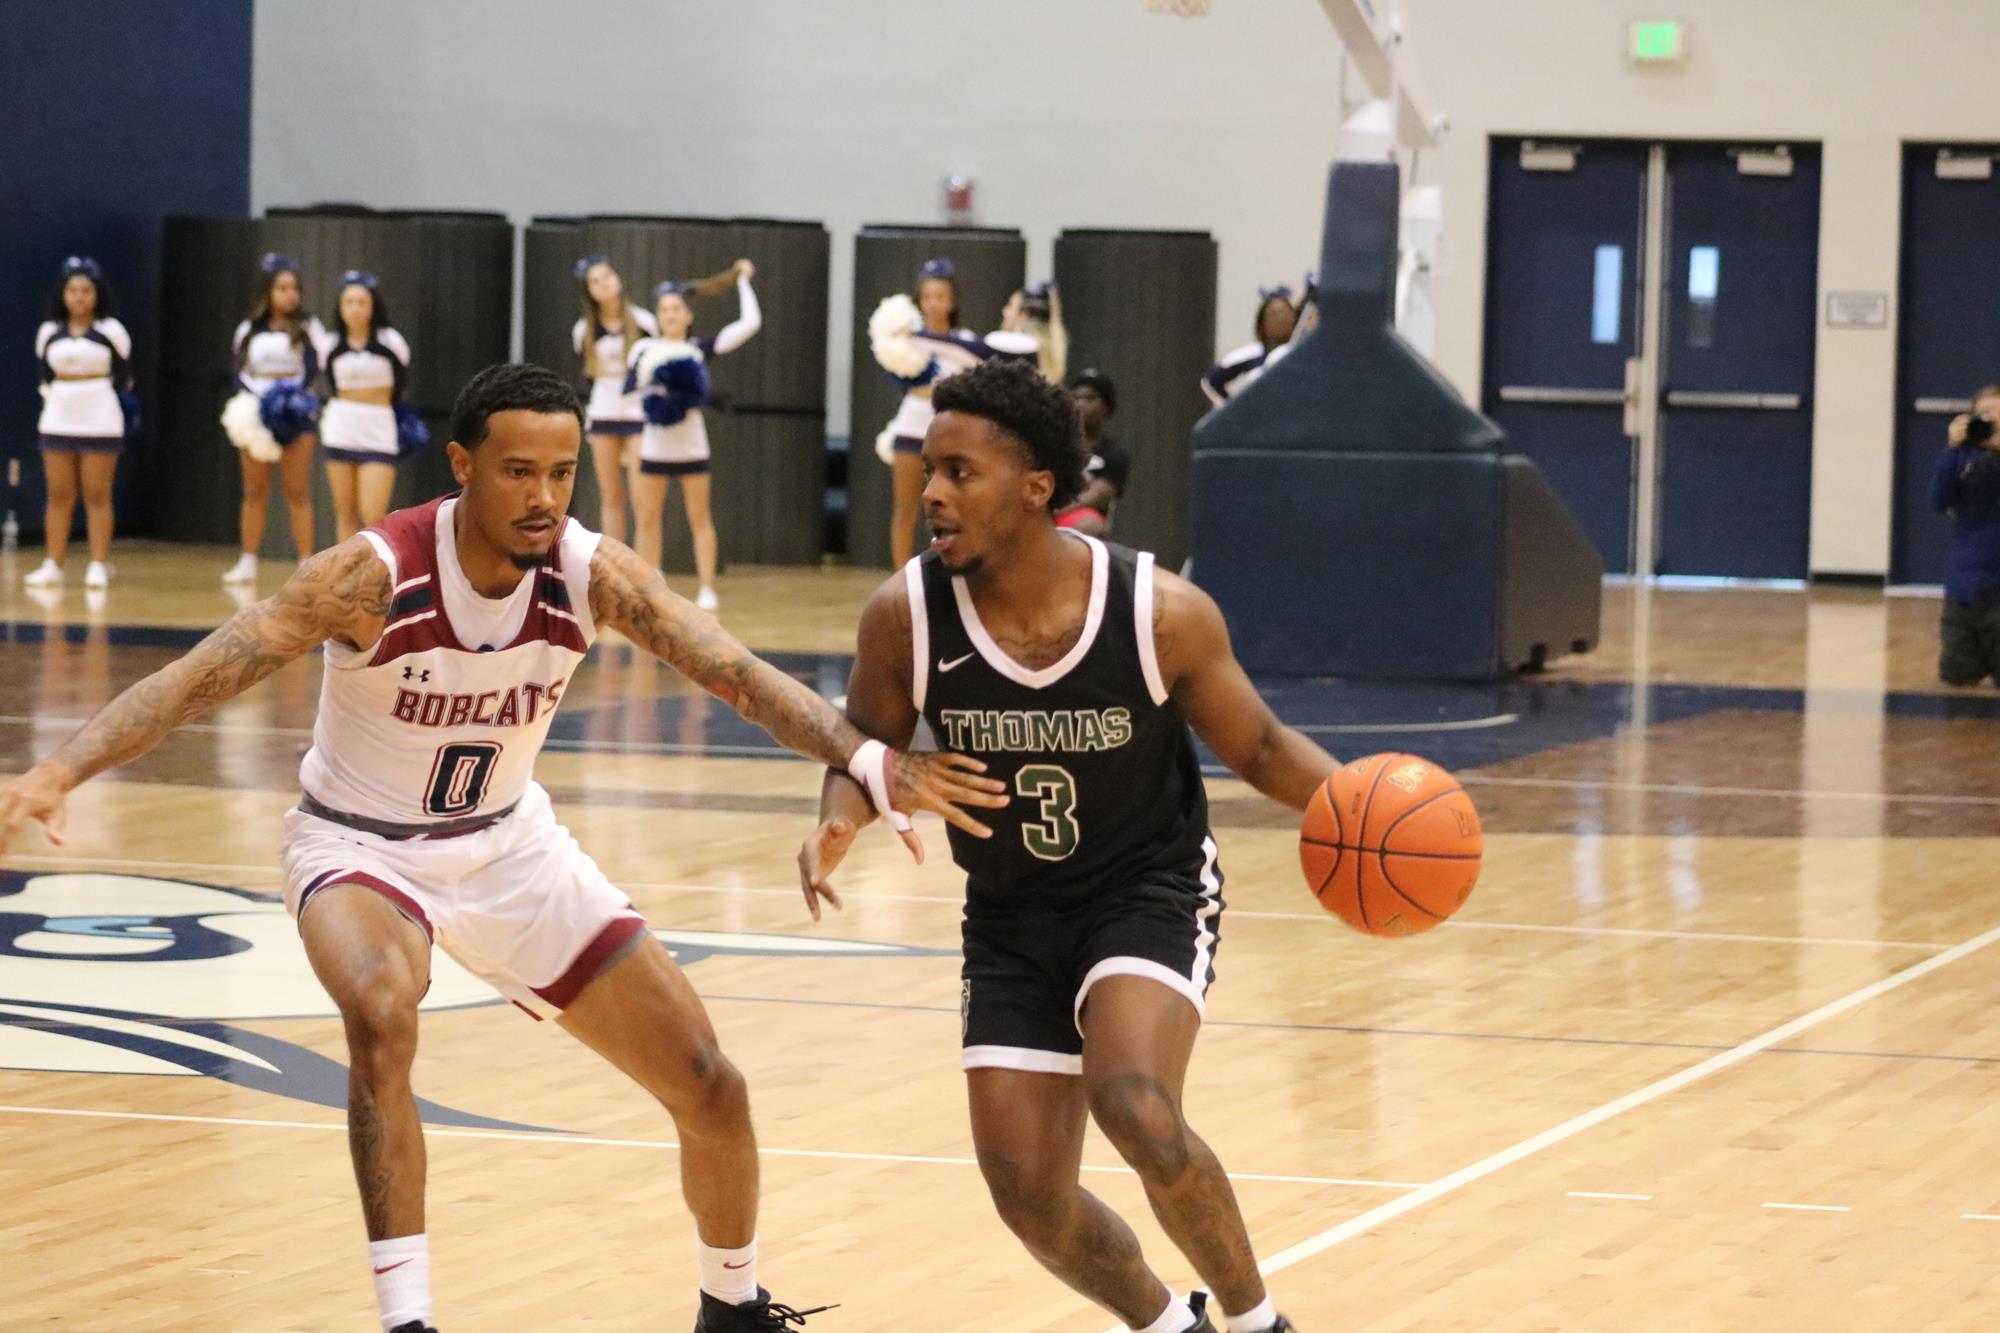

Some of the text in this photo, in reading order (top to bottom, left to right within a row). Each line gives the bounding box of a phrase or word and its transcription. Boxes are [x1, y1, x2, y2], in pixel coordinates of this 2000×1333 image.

[391, 678, 564, 728] BOBCATS
[940, 706, 1132, 752] THOMAS
[423, 741, 504, 817] 0
[1015, 764, 1080, 861] 3
